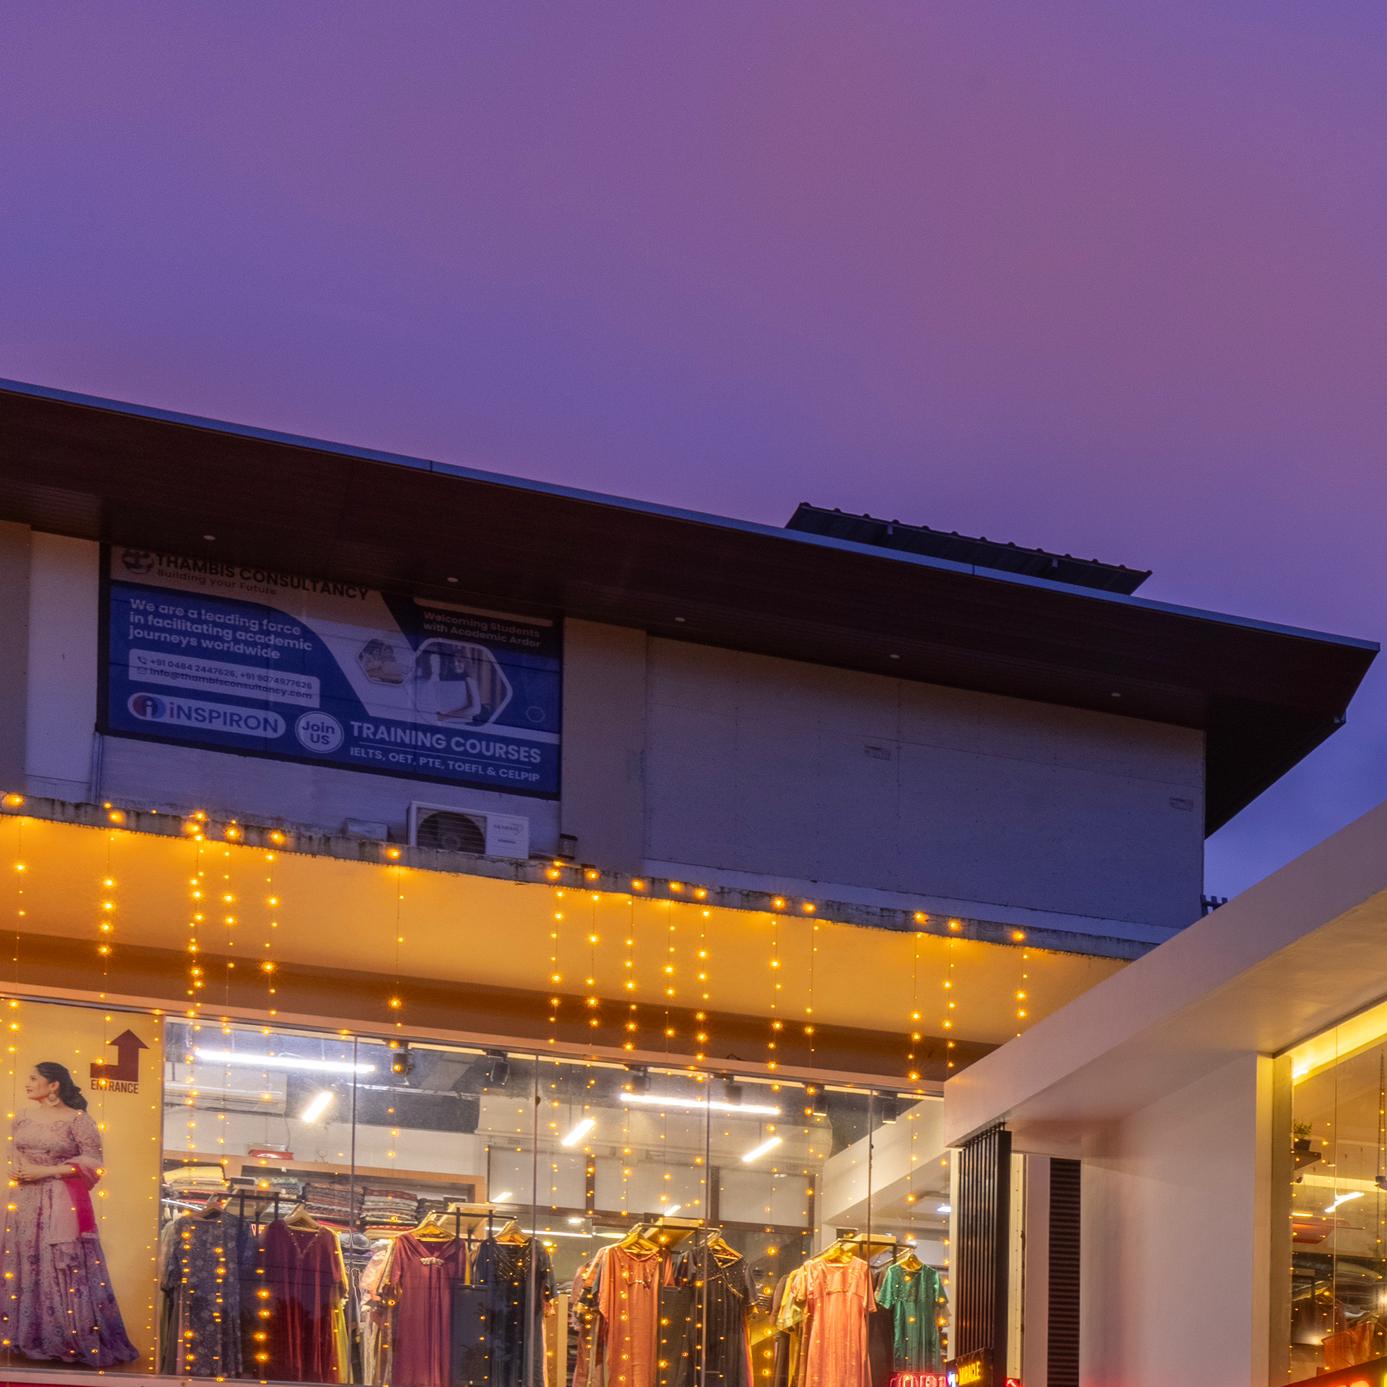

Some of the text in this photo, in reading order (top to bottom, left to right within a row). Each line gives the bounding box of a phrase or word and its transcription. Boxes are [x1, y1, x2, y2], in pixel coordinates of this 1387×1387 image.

[155, 553, 369, 600] THAMBIS CONSULTANCY
[157, 569, 206, 588] Building
[209, 577, 237, 591] your
[129, 598, 302, 636] We are a leading force
[129, 611, 313, 652] in facilitating academic
[424, 611, 541, 638] Welcoming Students
[424, 622, 448, 634] with
[450, 625, 507, 643] Academic
[128, 625, 281, 660] journeys worldwide
[169, 701, 278, 734] iNSPIRON
[302, 719, 335, 736] Join
[310, 733, 331, 746] US
[349, 721, 542, 764] TRAINING COURSES
[388, 752, 417, 766] OET,
[419, 757, 445, 770] PTE,
[447, 761, 485, 776] TOEFL
[486, 766, 497, 777] &
[499, 768, 541, 783] CELPIP
